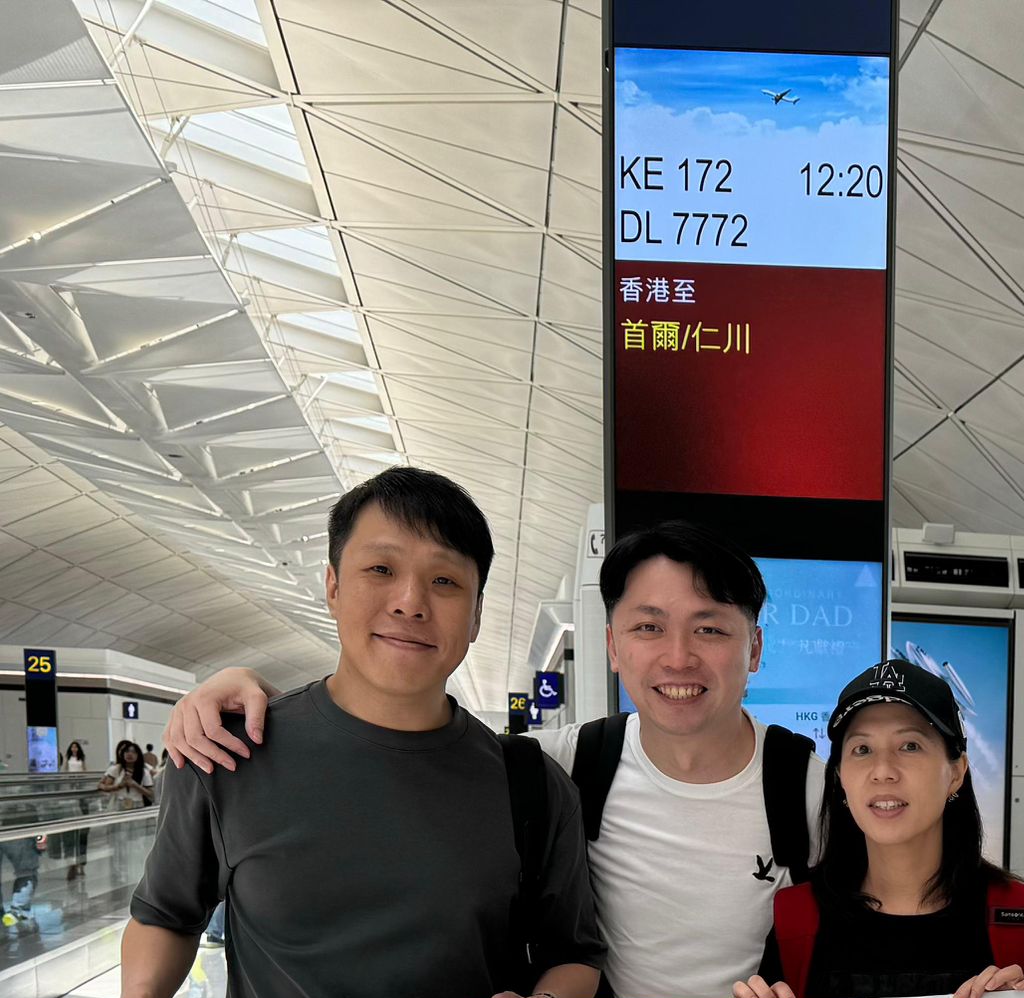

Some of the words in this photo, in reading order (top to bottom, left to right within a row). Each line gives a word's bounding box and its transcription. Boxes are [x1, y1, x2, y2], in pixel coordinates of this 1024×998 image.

[620, 156, 664, 190] KE
[678, 158, 732, 192] 172
[800, 162, 883, 198] 12:20
[620, 210, 662, 244] DL
[673, 212, 748, 247] 7772
[620, 276, 696, 304] 香港至
[621, 318, 750, 354] 首爾/仁川
[790, 603, 853, 627] DAD
[28, 656, 52, 673] 25
[510, 697, 527, 710] 26
[795, 711, 818, 721] HKG
